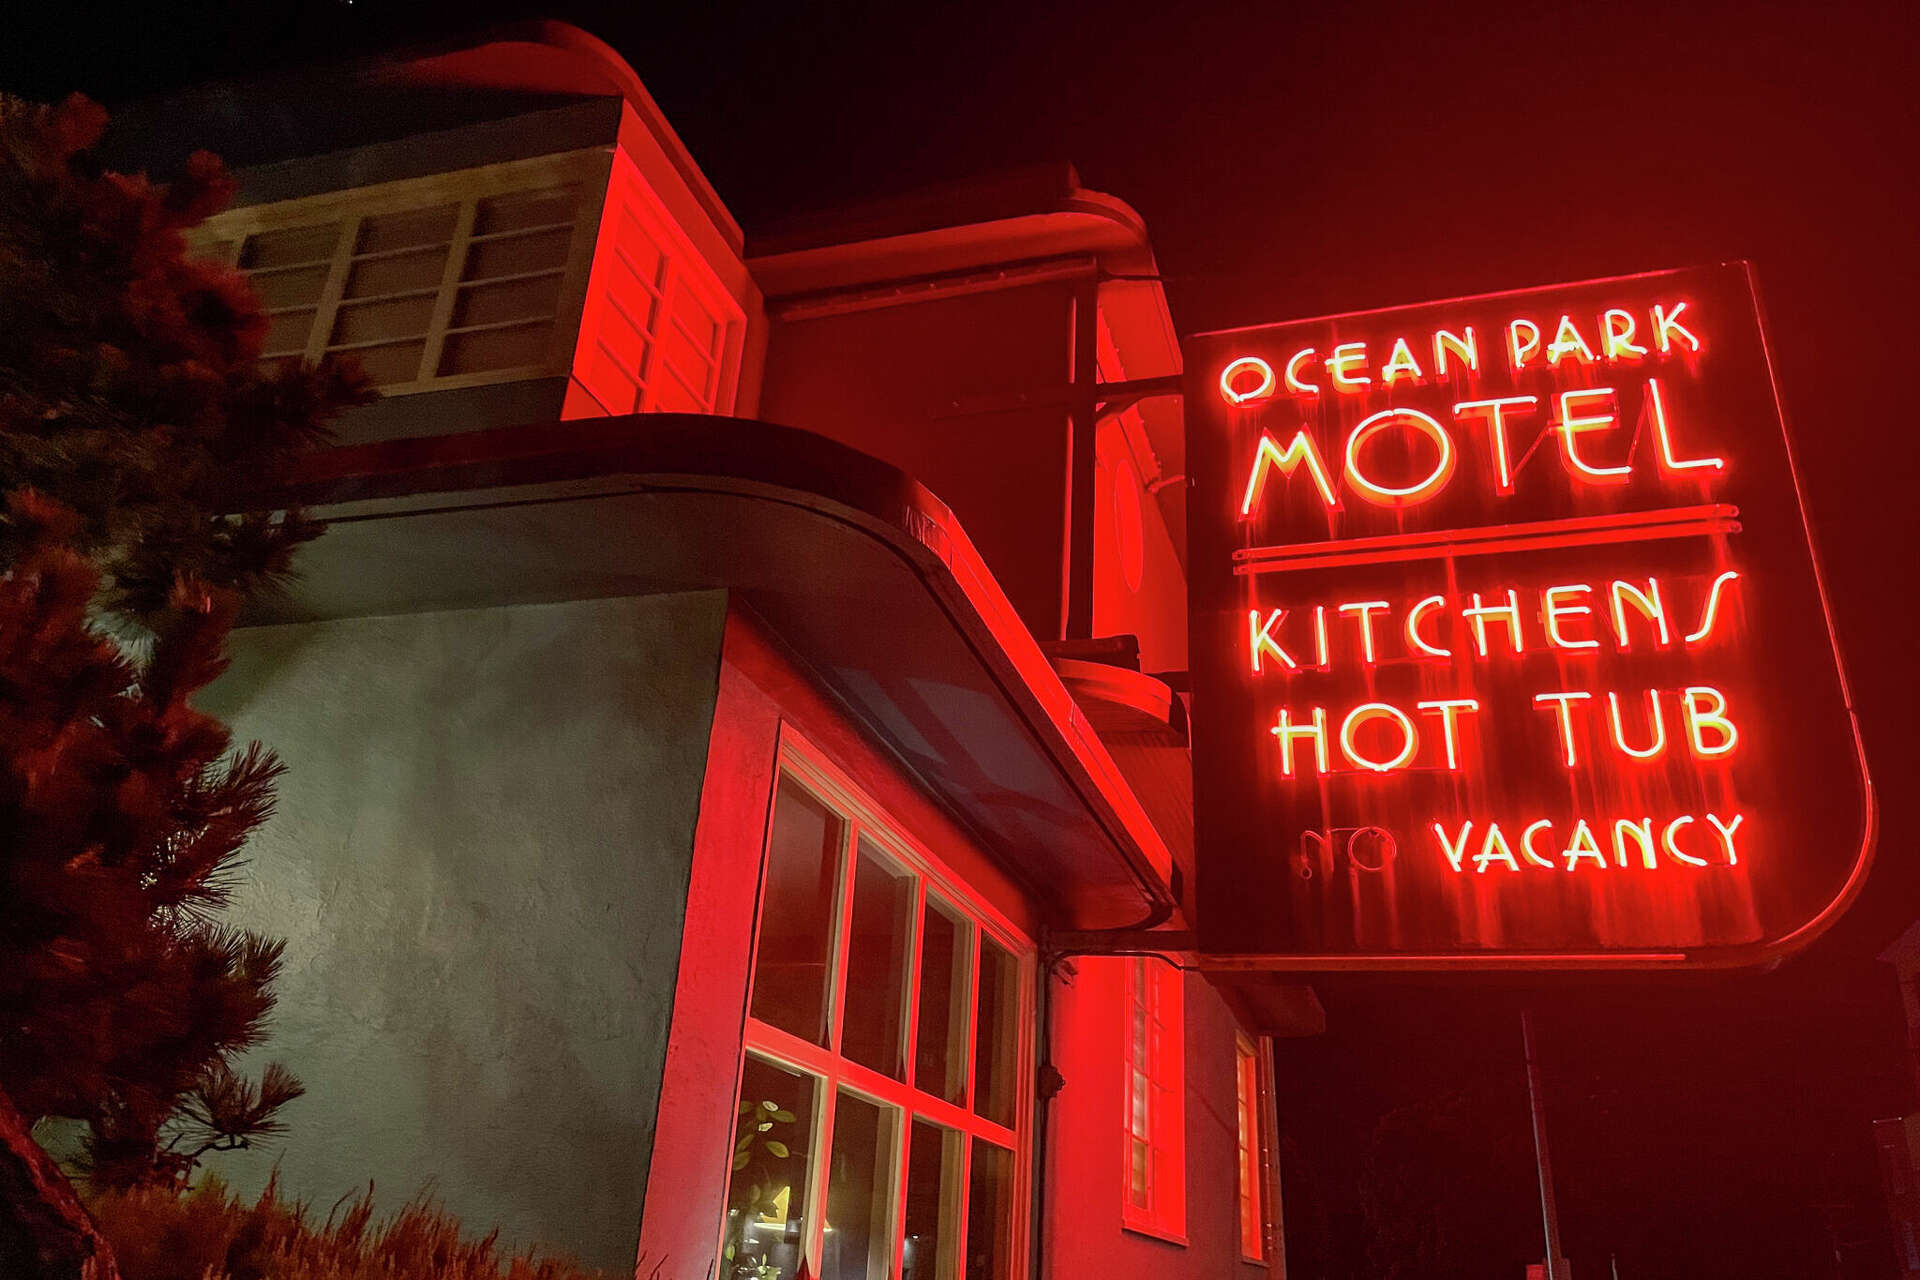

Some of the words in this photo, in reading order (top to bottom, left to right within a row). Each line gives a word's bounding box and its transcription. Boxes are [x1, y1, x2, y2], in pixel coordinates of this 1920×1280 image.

[1220, 326, 1478, 405] OCEAN
[1508, 302, 1699, 369] PARK
[1240, 377, 1724, 521] MOTEL
[1249, 571, 1740, 673] KITCHENS
[1271, 699, 1478, 777] HOT
[1534, 686, 1739, 767] TUB
[1433, 813, 1743, 872] VACANCY
